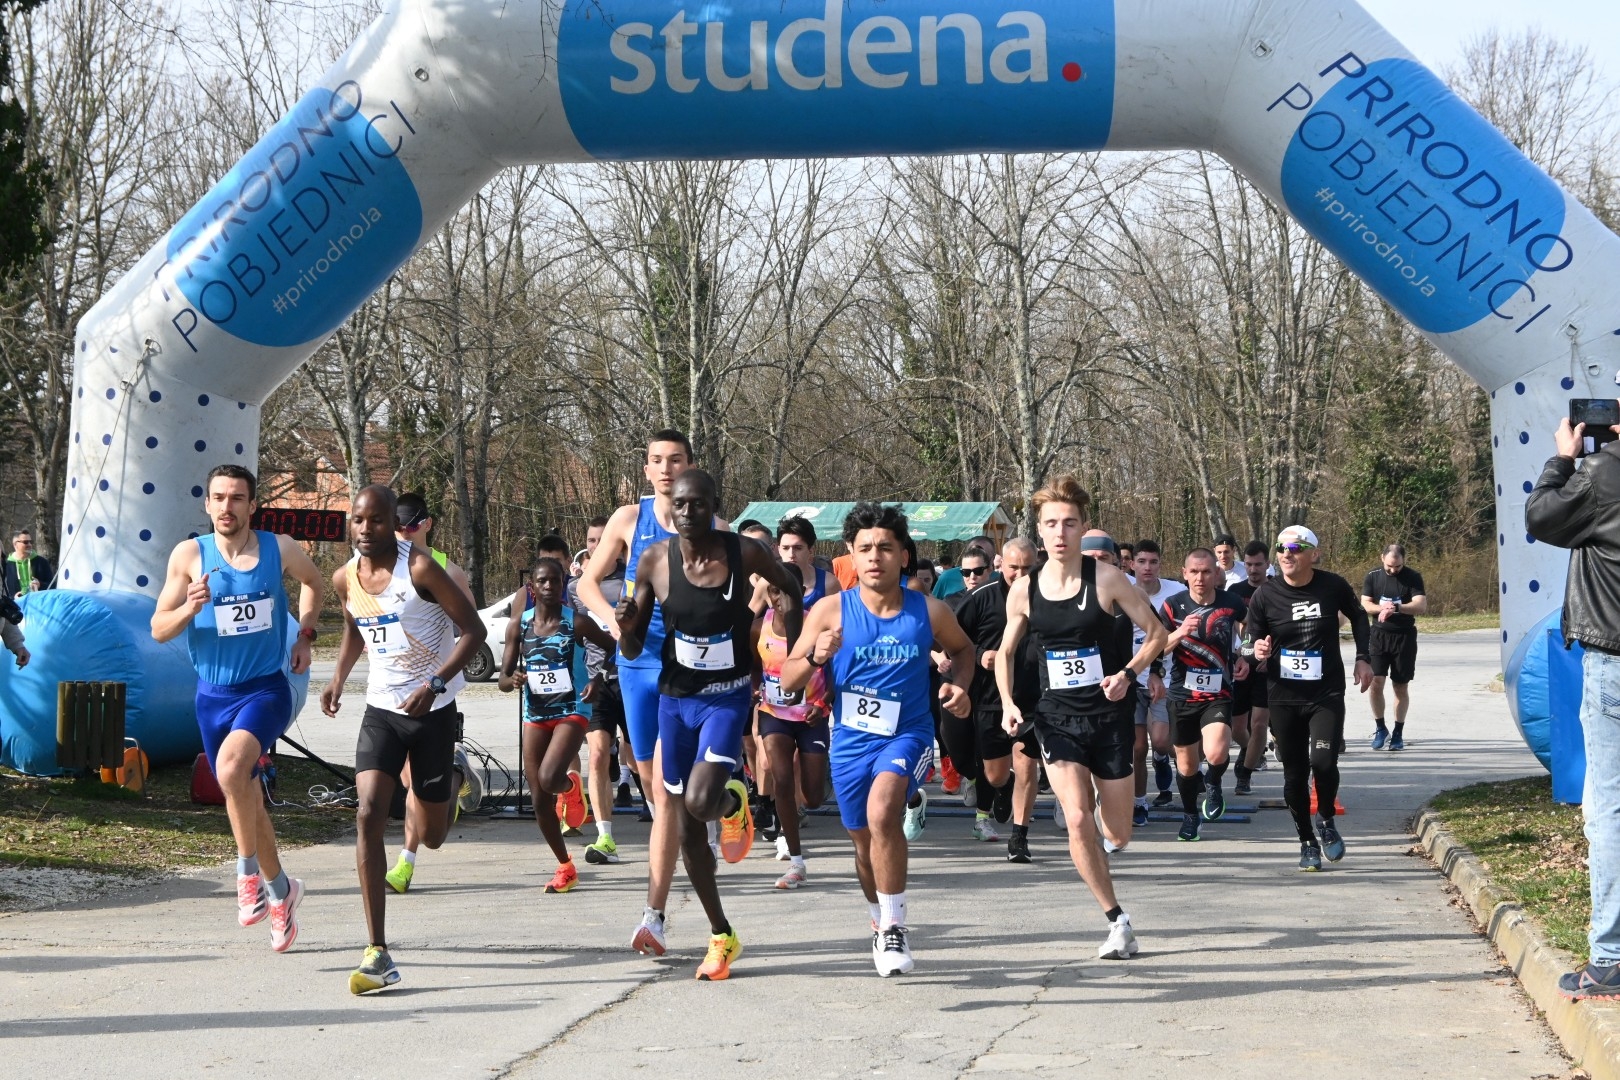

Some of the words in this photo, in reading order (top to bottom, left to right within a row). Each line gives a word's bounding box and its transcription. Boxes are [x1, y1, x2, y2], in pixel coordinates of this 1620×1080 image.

[1319, 51, 1574, 273] PRIRODNO
[154, 80, 362, 302] PRIRODNO
[1266, 82, 1552, 334] POBJEDNICI
[171, 100, 416, 353] POBJEDNICI
[231, 603, 256, 622] 20
[1292, 603, 1322, 621] 24
[368, 626, 386, 643] 27
[696, 646, 709, 659] 7
[854, 644, 919, 660] KUTINA
[1062, 659, 1086, 676] 38
[1291, 658, 1310, 671] 35
[537, 672, 557, 685] 28
[1196, 674, 1211, 685] 61
[864, 687, 878, 695] RUN
[857, 697, 882, 719] 82
